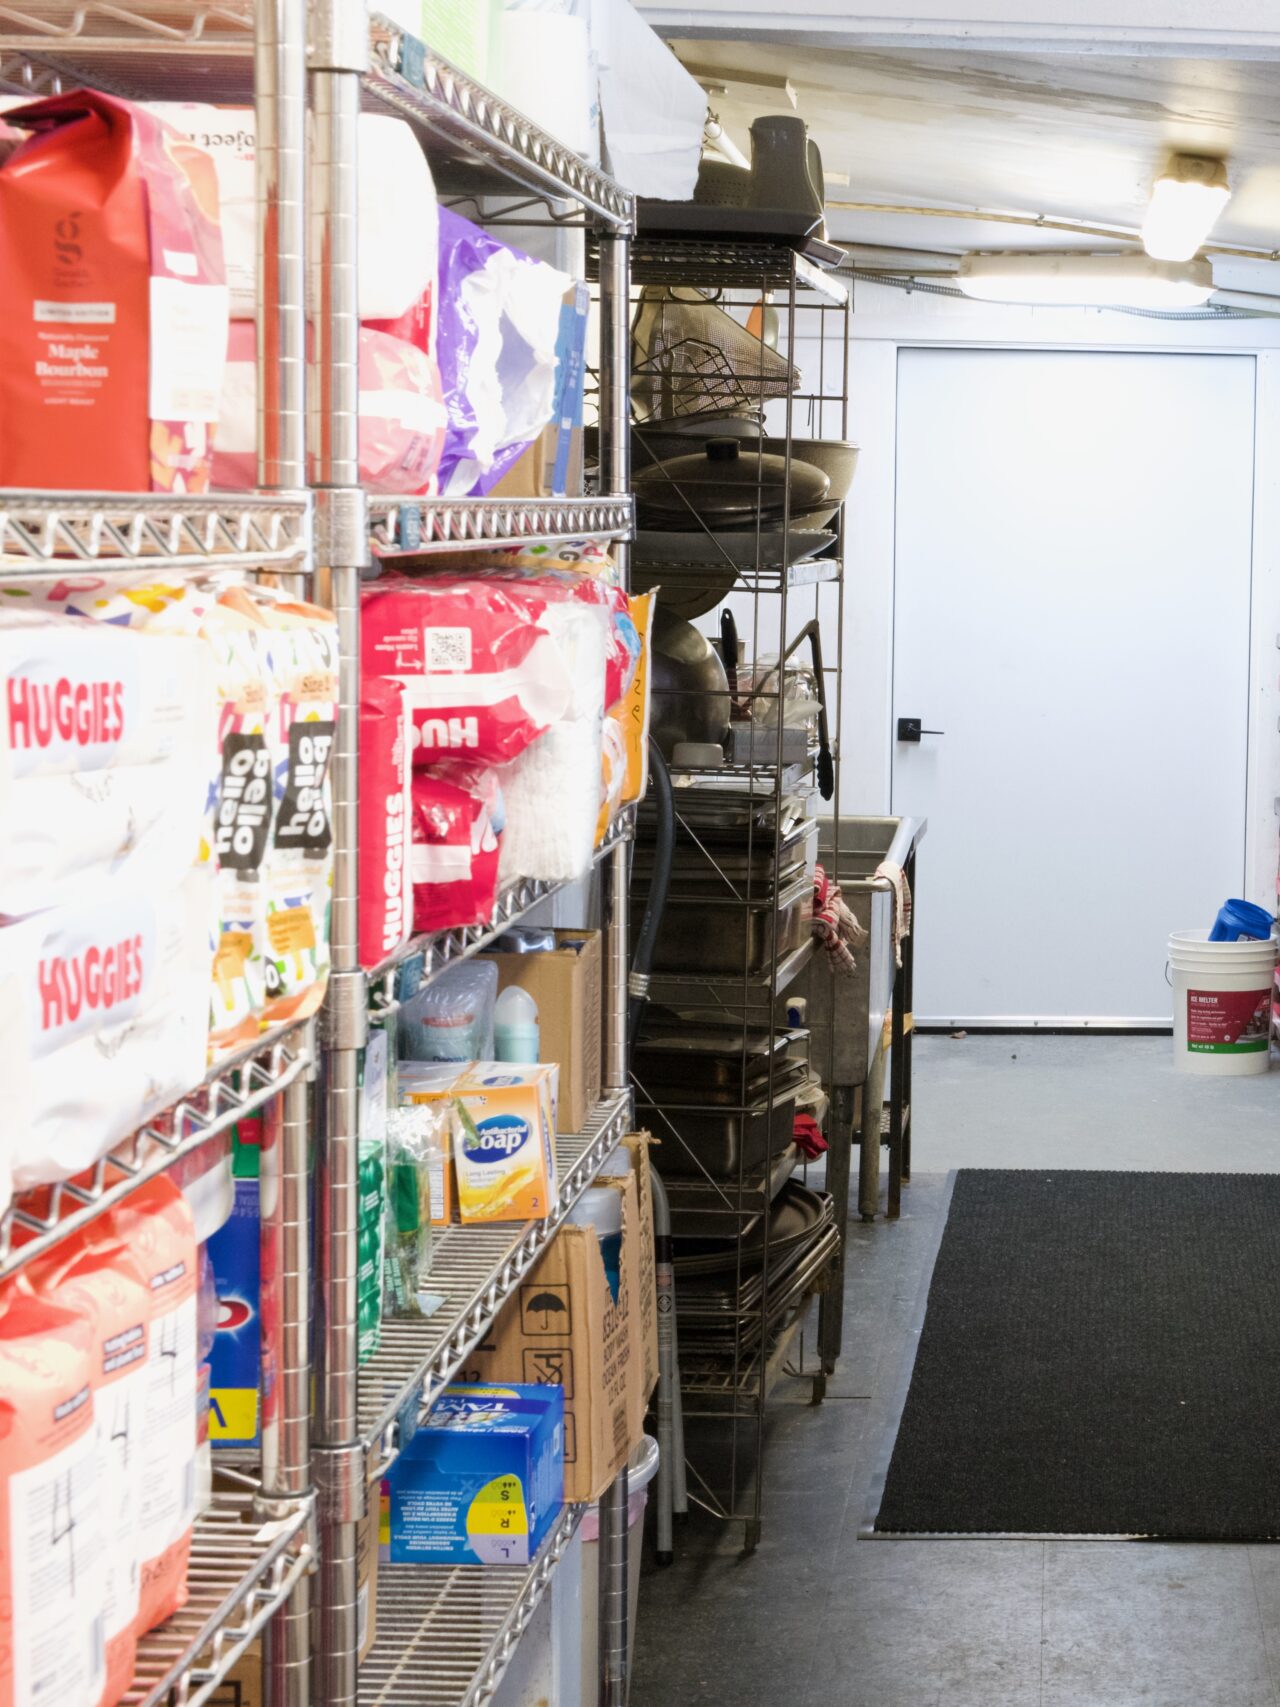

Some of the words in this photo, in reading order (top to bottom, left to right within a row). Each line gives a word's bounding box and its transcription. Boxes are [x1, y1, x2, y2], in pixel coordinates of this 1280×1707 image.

[48, 343, 99, 364] Maple
[35, 361, 109, 378] Bourbon
[8, 677, 123, 749] HUGGIES
[278, 736, 316, 836] hello
[215, 749, 256, 854] hello
[232, 748, 271, 856] bello
[383, 791, 405, 952] HUGGIES
[38, 933, 144, 1031] HUGGIES
[1198, 996, 1218, 1004] MELTER
[480, 1124, 528, 1137] Antibacterial
[532, 1197, 540, 1207] 2
[500, 1490, 510, 1501] S
[500, 1518, 510, 1529] R
[501, 1548, 510, 1558] L
